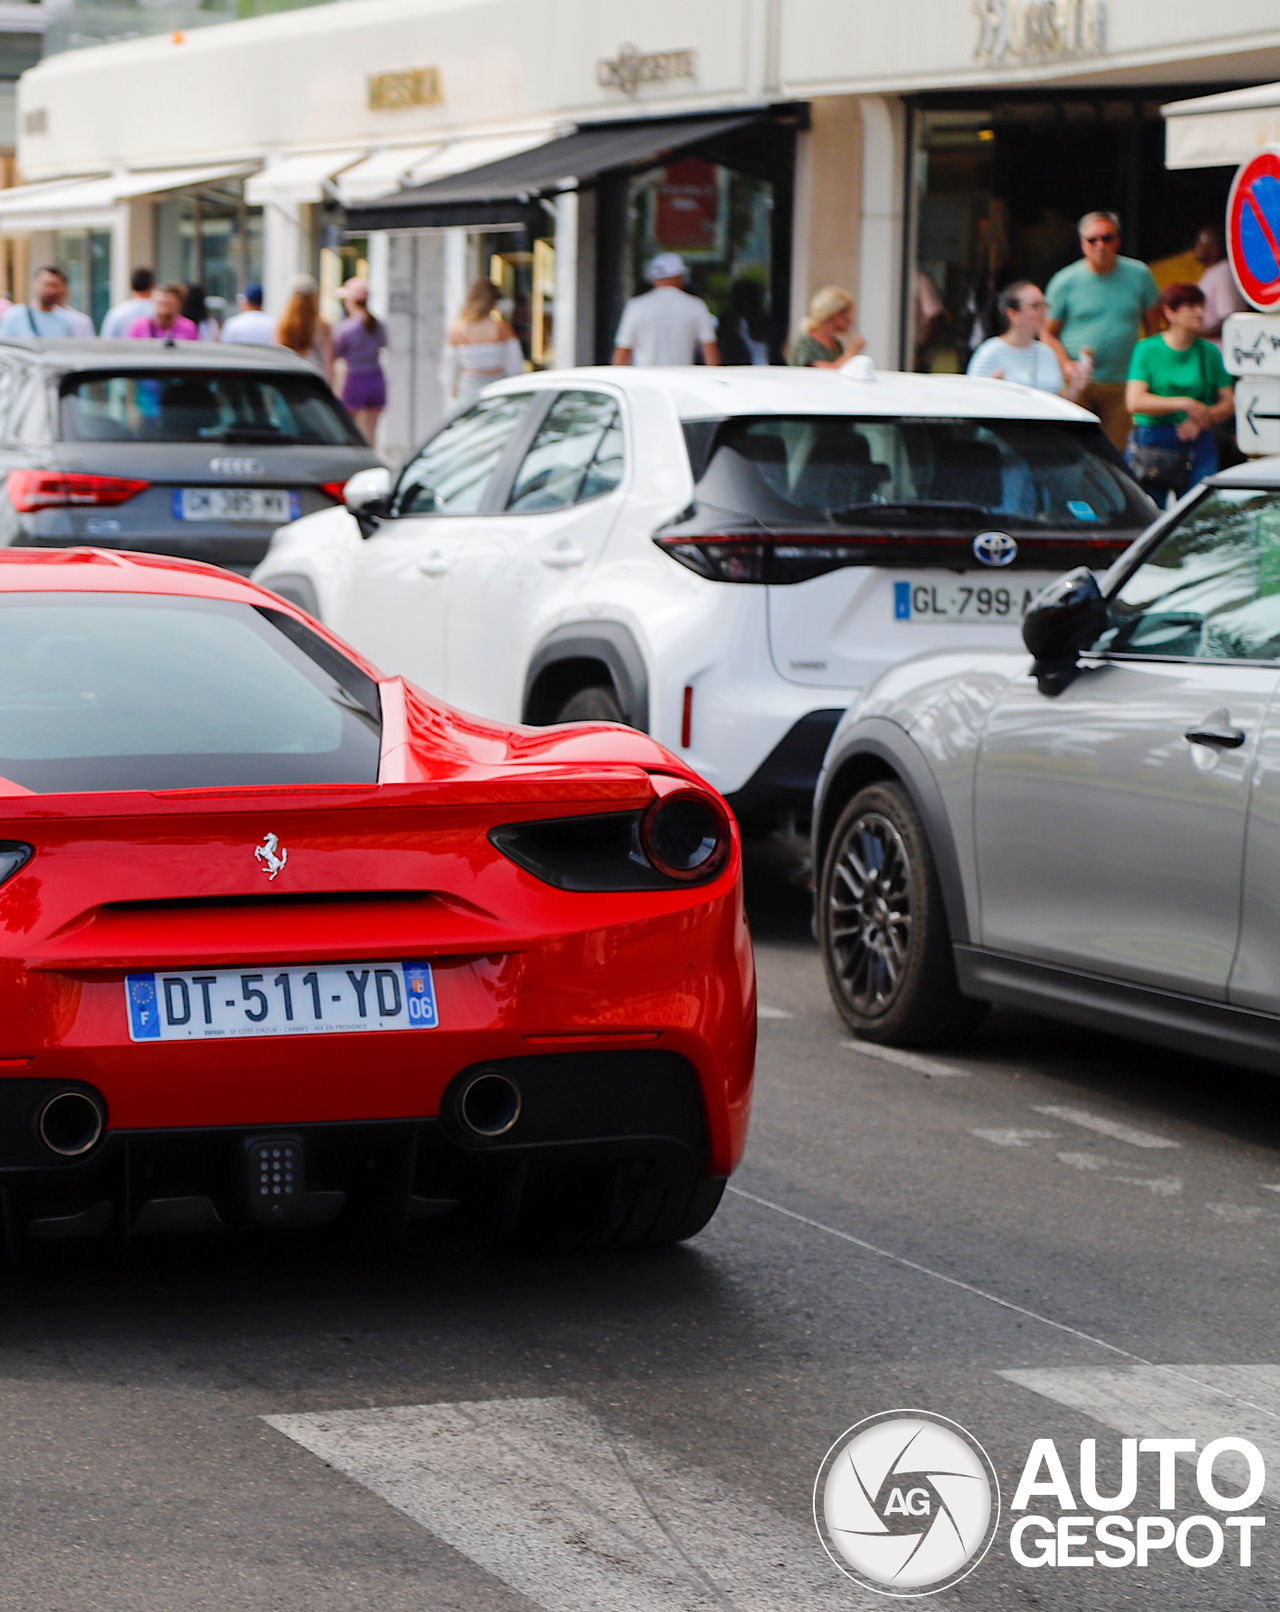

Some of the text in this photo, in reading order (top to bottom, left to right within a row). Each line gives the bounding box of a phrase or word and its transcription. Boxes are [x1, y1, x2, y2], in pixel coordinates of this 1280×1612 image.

[163, 970, 402, 1025] DT-511-YD
[409, 997, 433, 1019] 06
[140, 1011, 150, 1026] F
